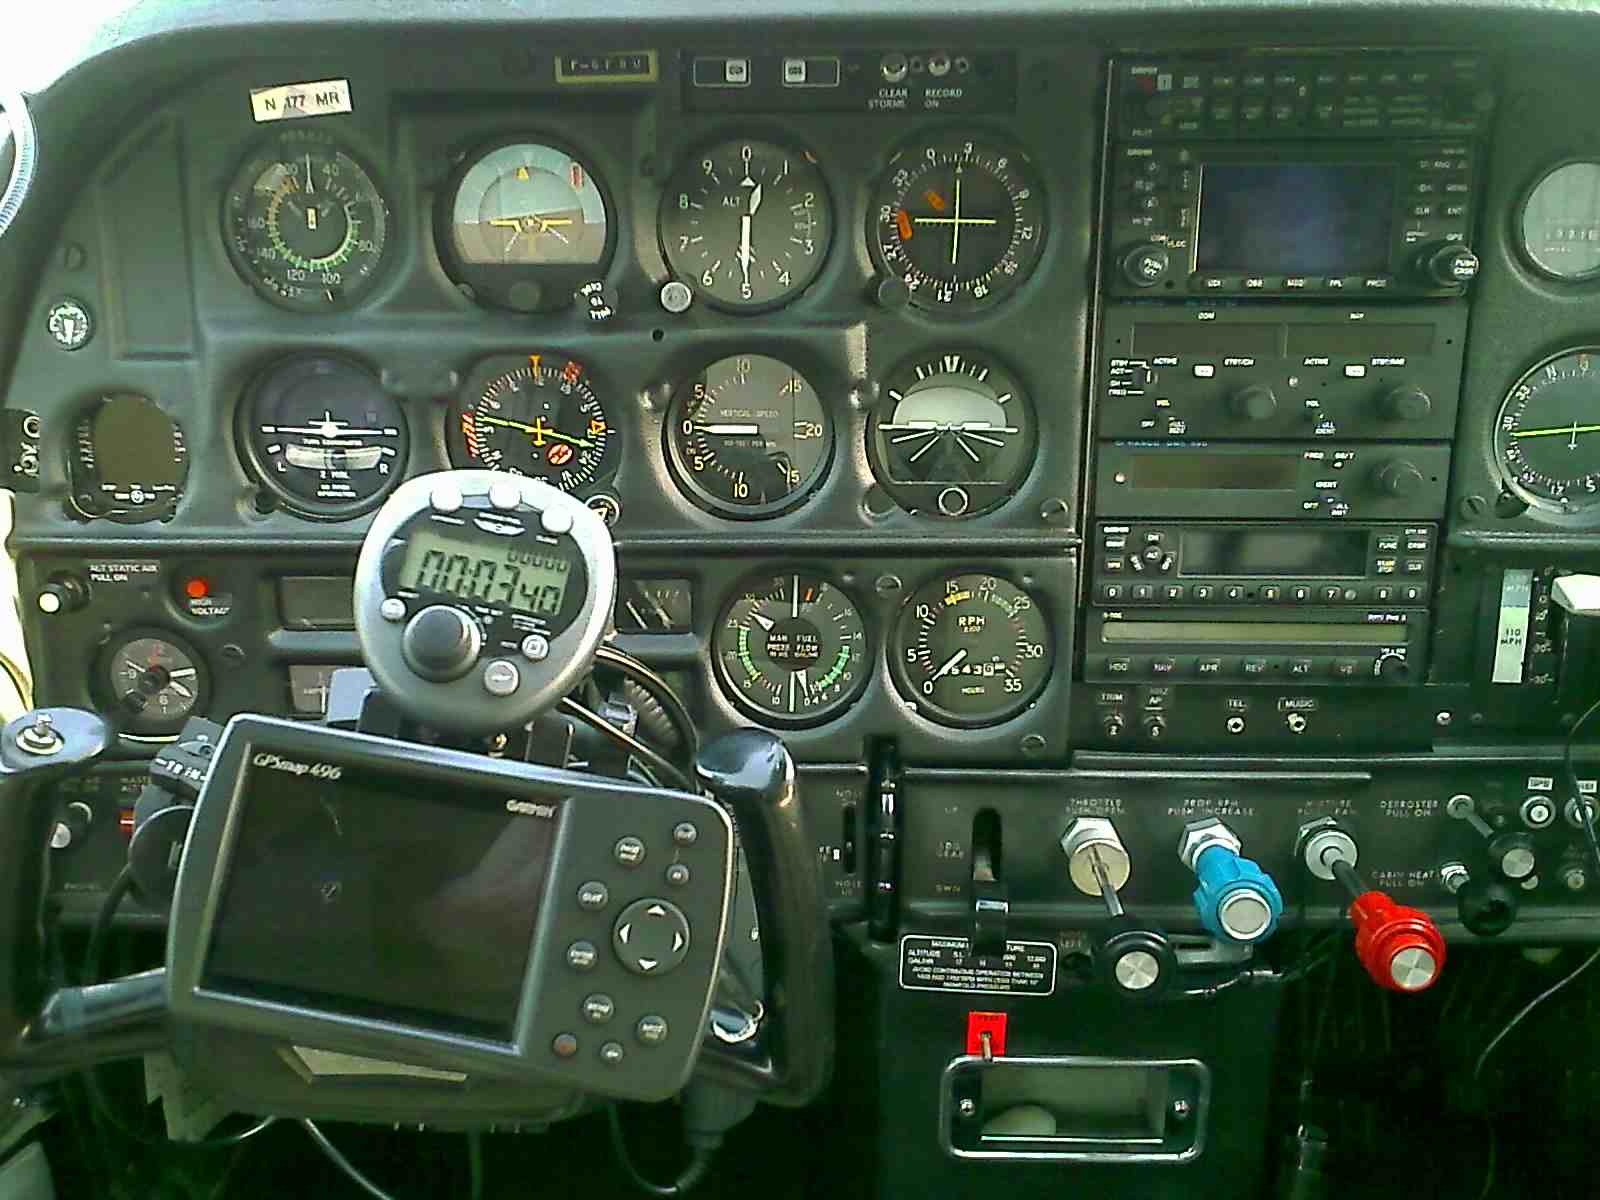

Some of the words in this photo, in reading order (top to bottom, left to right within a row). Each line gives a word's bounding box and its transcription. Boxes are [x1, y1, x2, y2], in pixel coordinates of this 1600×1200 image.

[878, 88, 908, 97] CLEAR
[925, 88, 963, 98] RECORD
[265, 99, 277, 111] N
[316, 92, 339, 106] MR
[924, 100, 939, 109] ON
[742, 146, 751, 161] 0
[703, 159, 713, 175] 9
[679, 193, 689, 209] 8
[722, 196, 741, 207] ALT
[804, 192, 814, 208] 2
[680, 236, 689, 252] 7
[804, 240, 814, 255] 3
[287, 269, 305, 281] 120
[322, 273, 341, 284] 100
[702, 270, 713, 286] 6
[778, 271, 791, 286] 4
[741, 283, 752, 299] 5
[737, 359, 751, 374] 10
[694, 384, 704, 398] 5
[683, 420, 692, 435] 0
[806, 425, 823, 437] 20
[278, 462, 287, 472] L
[379, 463, 389, 474] R
[694, 457, 704, 471] 5
[786, 470, 800, 484] 15
[734, 483, 748, 498] 10
[107, 565, 140, 573] STATIC
[946, 580, 959, 593] 15
[979, 577, 997, 591] 20
[1013, 596, 1031, 610] 25
[916, 604, 929, 618] 10
[958, 616, 985, 625] RPM
[907, 649, 917, 662] 5
[1025, 645, 1043, 658] 30
[1292, 665, 1308, 673] ALT
[923, 681, 933, 694] 0
[1004, 679, 1022, 692] 35
[159, 695, 168, 705] 6
[772, 697, 780, 705] 10
[1102, 693, 1123, 701] TRIM
[1285, 699, 1315, 708] MUSIC
[311, 764, 343, 780] 496
[1380, 800, 1438, 809] DEFROSTER
[1168, 808, 1194, 816] PUSH
[1414, 808, 1431, 817] ON
[1408, 871, 1434, 880] HEAT
